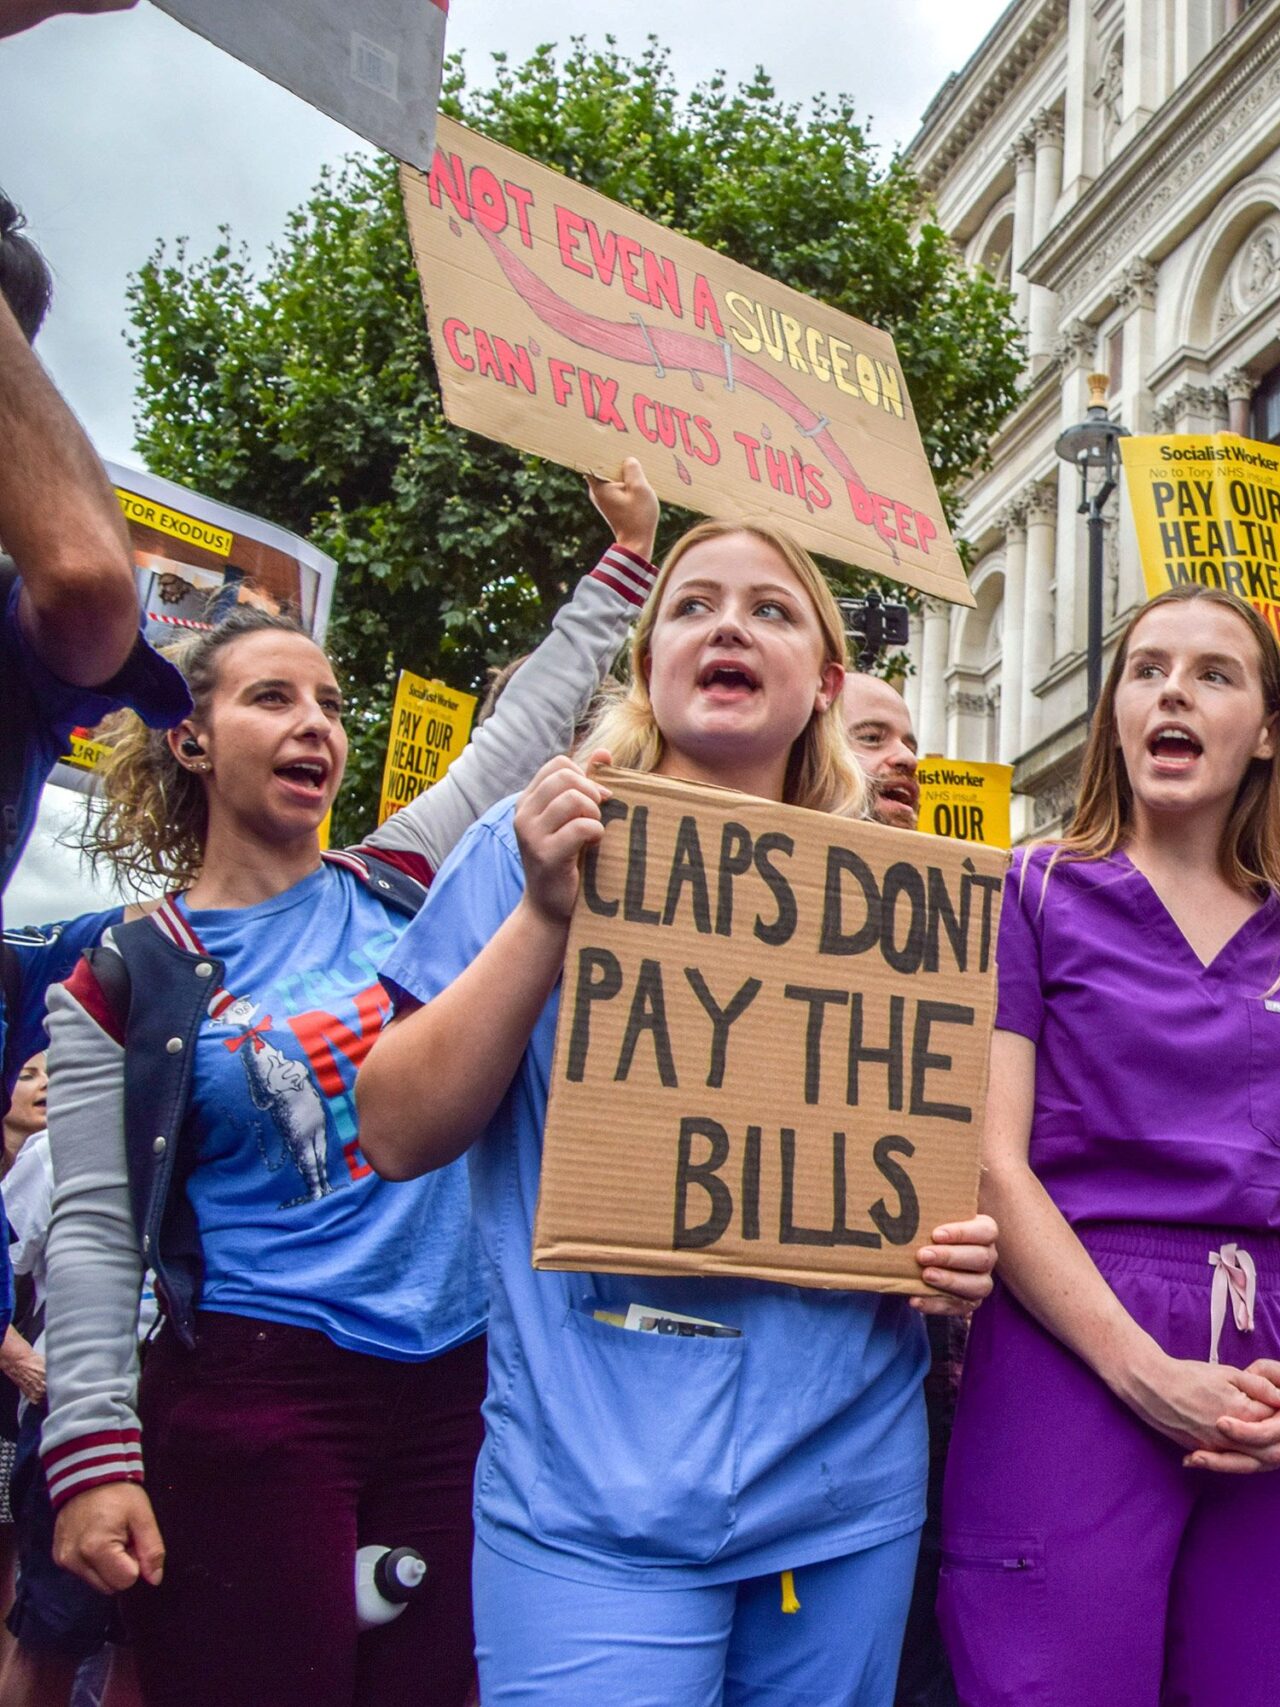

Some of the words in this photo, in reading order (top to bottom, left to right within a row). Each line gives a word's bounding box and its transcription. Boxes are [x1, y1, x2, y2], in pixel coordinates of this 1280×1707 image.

[428, 147, 534, 249] NOT
[554, 203, 683, 318] EVEN
[694, 274, 724, 338] A
[725, 290, 906, 420] SURGEON
[443, 318, 537, 395] CAN
[548, 357, 629, 433] FIX
[633, 392, 720, 466] CUTS
[733, 431, 832, 510] THIS
[846, 480, 938, 555] DEEP
[1149, 468, 1168, 479] No
[1171, 467, 1184, 477] to
[1187, 466, 1213, 479] Tory
[1217, 467, 1245, 478] NHS
[1160, 445, 1233, 461] Socialist
[1231, 446, 1280, 471] Worker
[1151, 480, 1214, 518] PAY
[117, 496, 155, 522] TOR
[160, 514, 231, 551] EXODUS!
[1159, 520, 1279, 562] HEALTH
[397, 709, 422, 741] PAY
[426, 718, 454, 752] OUR
[392, 739, 440, 778] HEALTH
[941, 769, 985, 787] Worker
[925, 791, 950, 801] NHS
[933, 803, 984, 841] OUR
[582, 797, 798, 947] CLAPS
[819, 846, 1002, 975] DON'T
[566, 947, 762, 1089] PAY
[784, 984, 975, 1123] THE
[673, 1116, 920, 1250] BILLS
